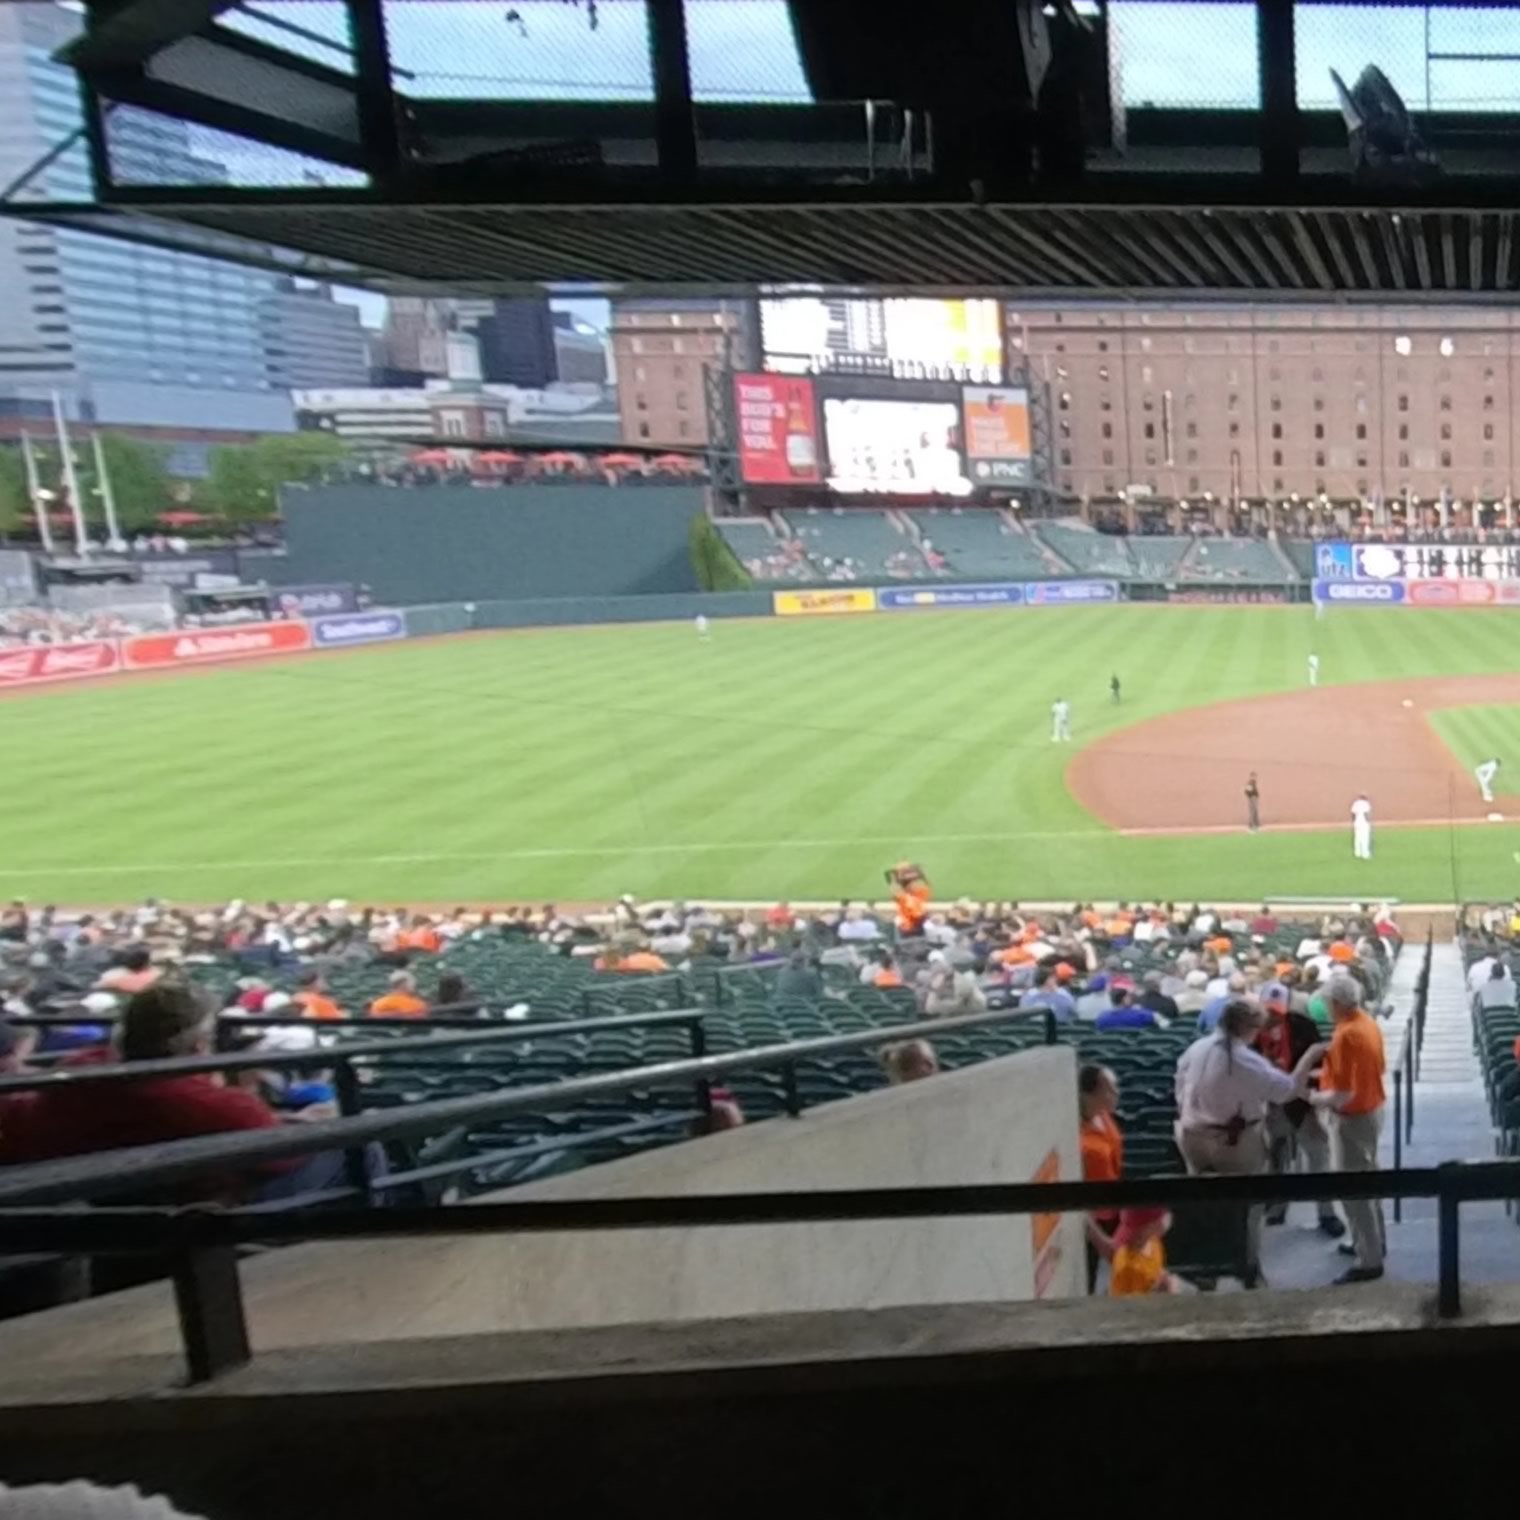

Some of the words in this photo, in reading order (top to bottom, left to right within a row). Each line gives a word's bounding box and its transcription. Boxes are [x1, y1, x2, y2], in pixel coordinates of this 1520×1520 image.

[741, 418, 773, 433] FOR
[992, 463, 1025, 477] PNC
[1328, 583, 1393, 599] GEICO
